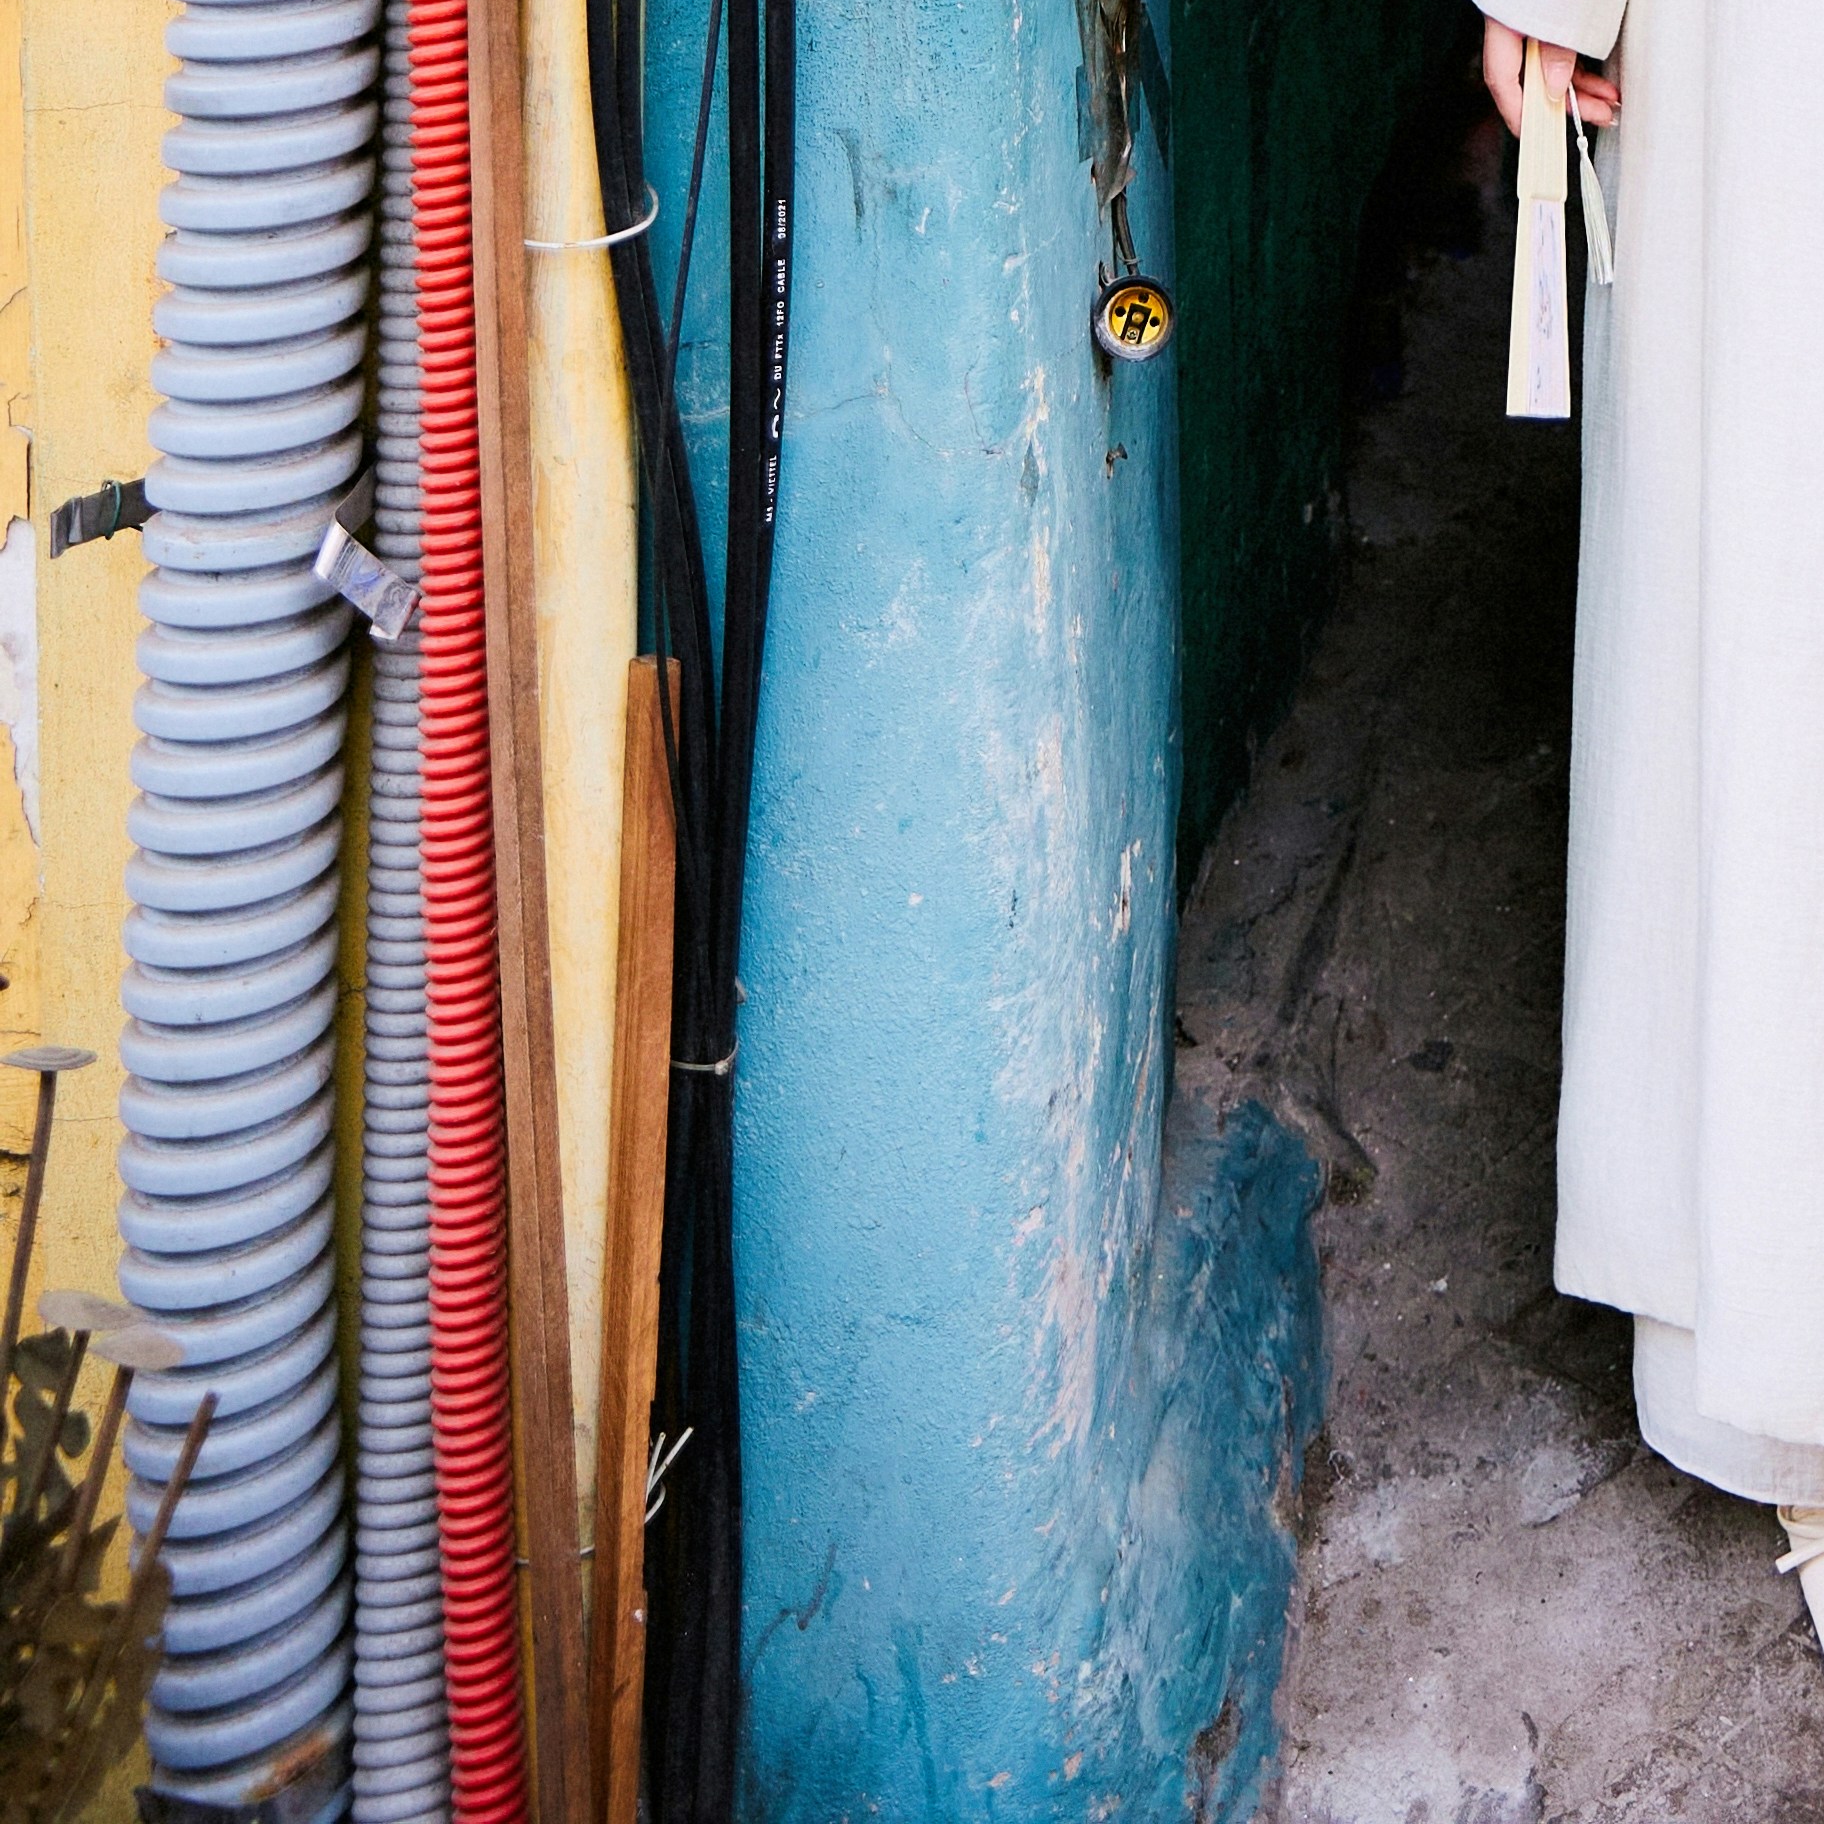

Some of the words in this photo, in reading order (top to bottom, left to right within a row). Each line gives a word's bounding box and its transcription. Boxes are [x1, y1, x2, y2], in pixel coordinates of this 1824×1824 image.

[777, 258, 787, 294] CABLE
[776, 300, 786, 327] 12FO
[773, 364, 784, 381] DU
[767, 454, 778, 496] VIETTEL
